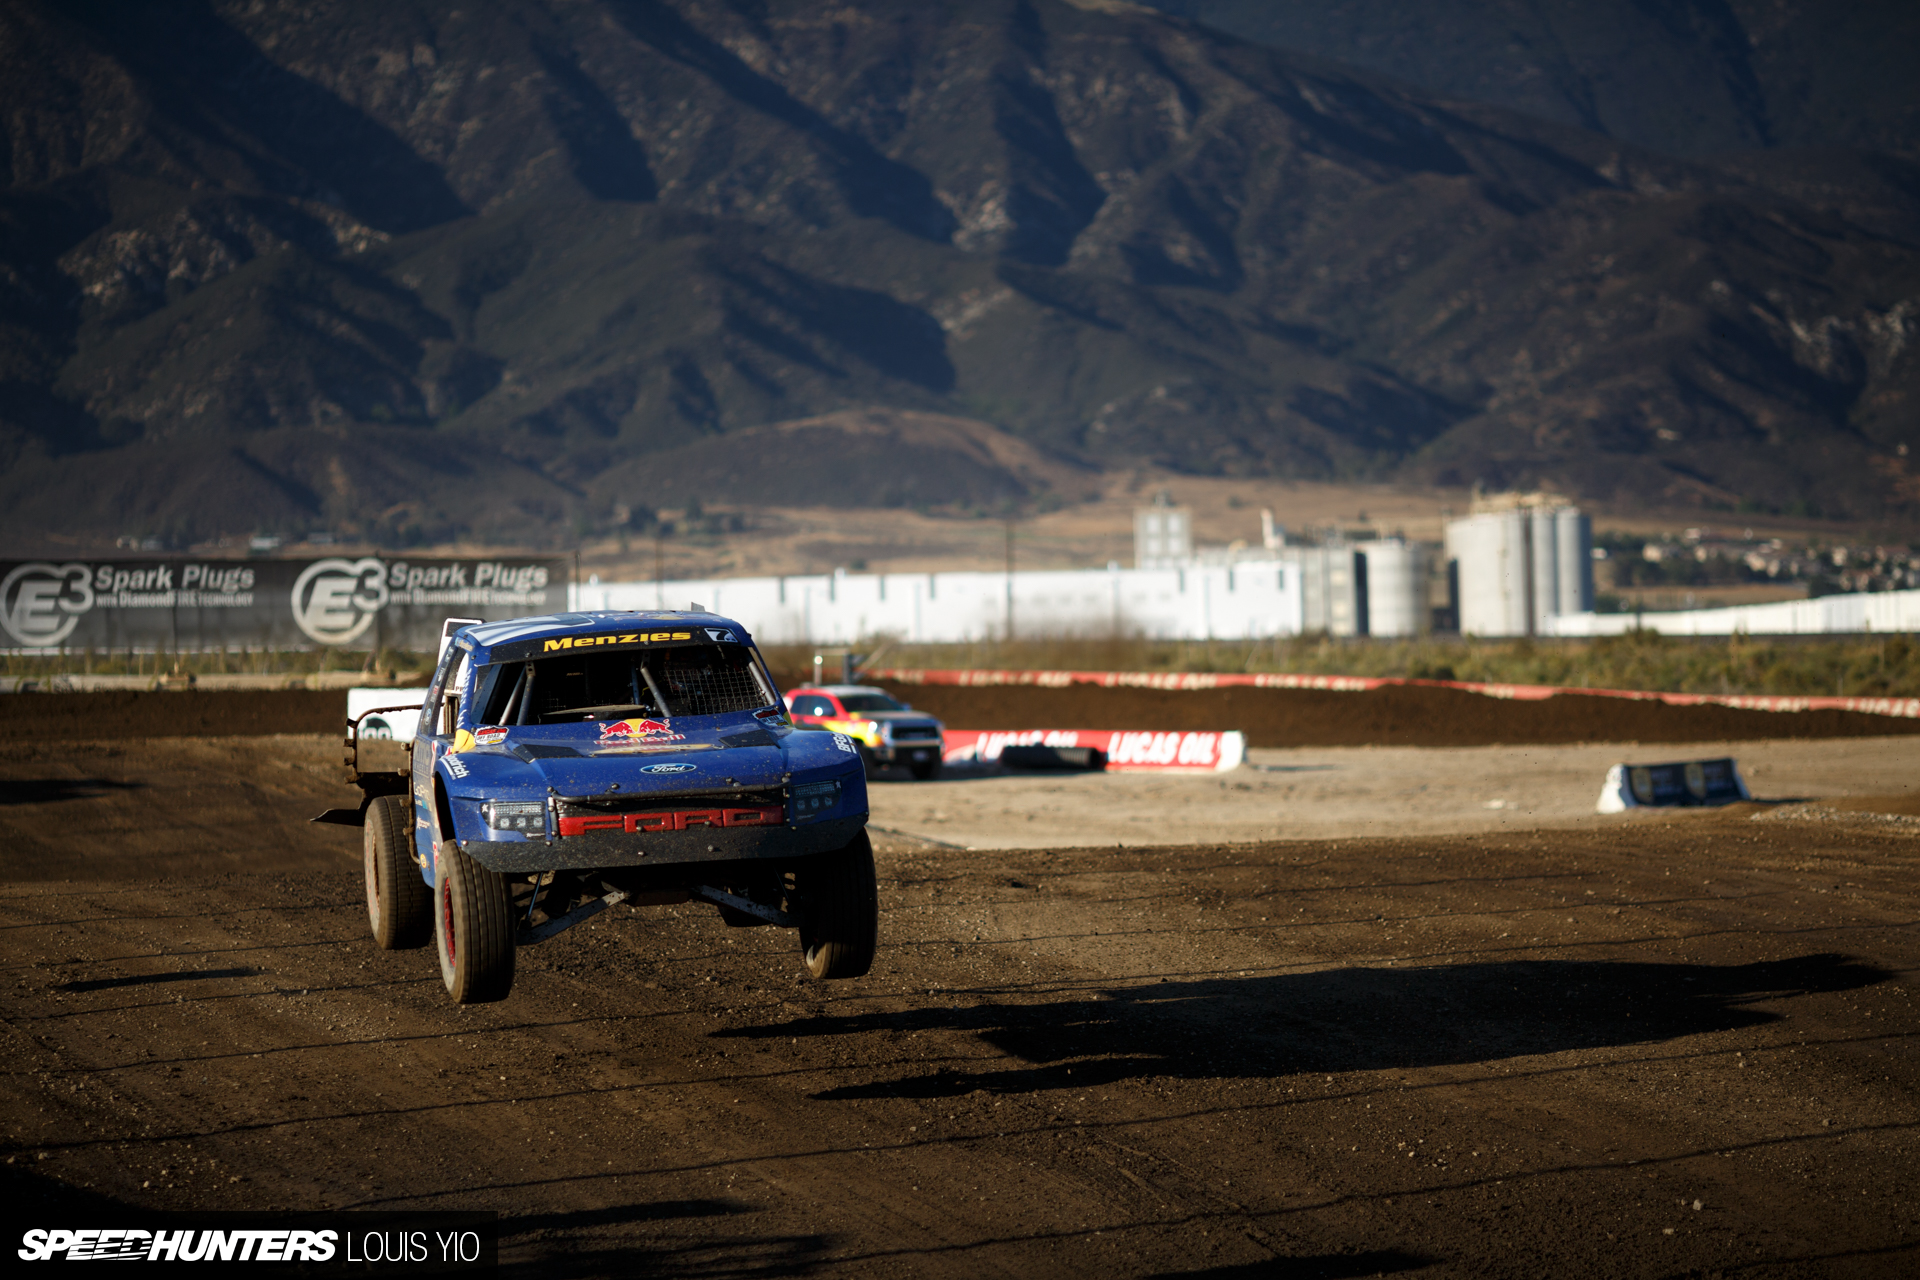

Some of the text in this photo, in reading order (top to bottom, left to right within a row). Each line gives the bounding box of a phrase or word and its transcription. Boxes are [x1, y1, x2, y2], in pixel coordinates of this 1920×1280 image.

[95, 565, 255, 593] Spark Plugs
[390, 562, 549, 594] Spark Plugs
[544, 632, 691, 653] Menzies
[1108, 731, 1216, 764] LUCAS OIL
[650, 764, 687, 773] Ford
[558, 805, 783, 836] FORD
